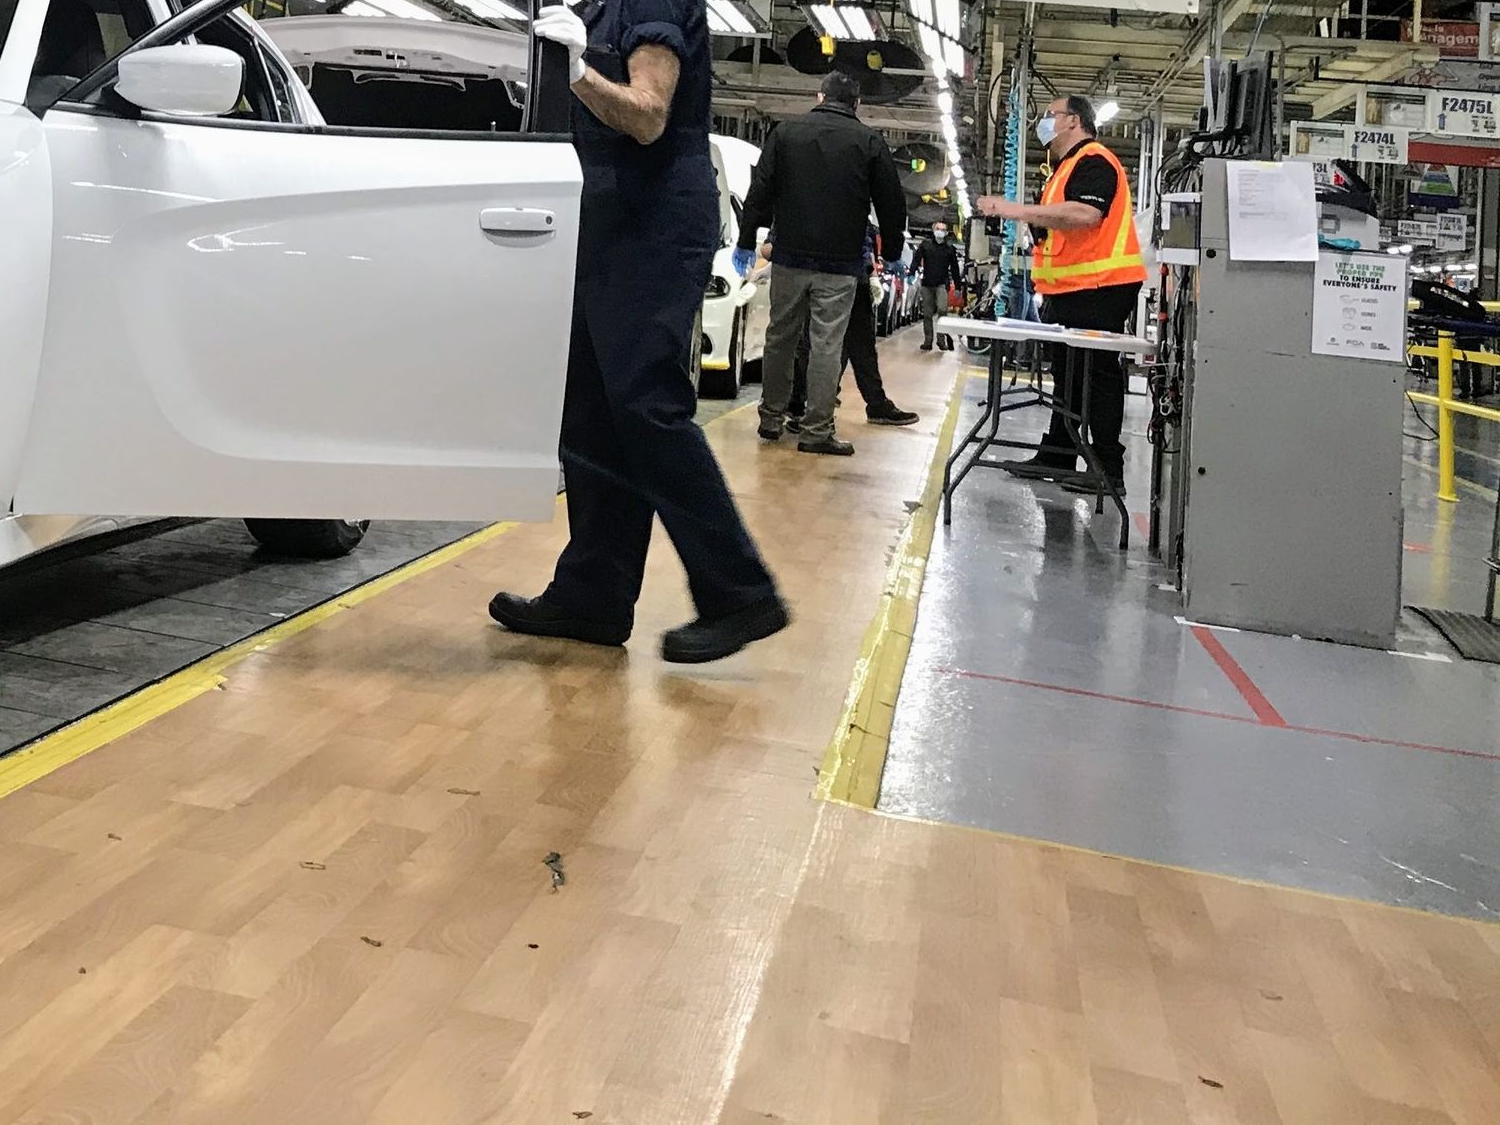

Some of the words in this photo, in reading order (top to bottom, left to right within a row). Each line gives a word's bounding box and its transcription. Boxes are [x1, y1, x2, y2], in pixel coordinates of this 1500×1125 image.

[1442, 97, 1493, 115] F2475L
[1354, 130, 1396, 145] F2474L
[1323, 280, 1368, 289] EVERYONE'S
[1352, 276, 1380, 284] ENSURE
